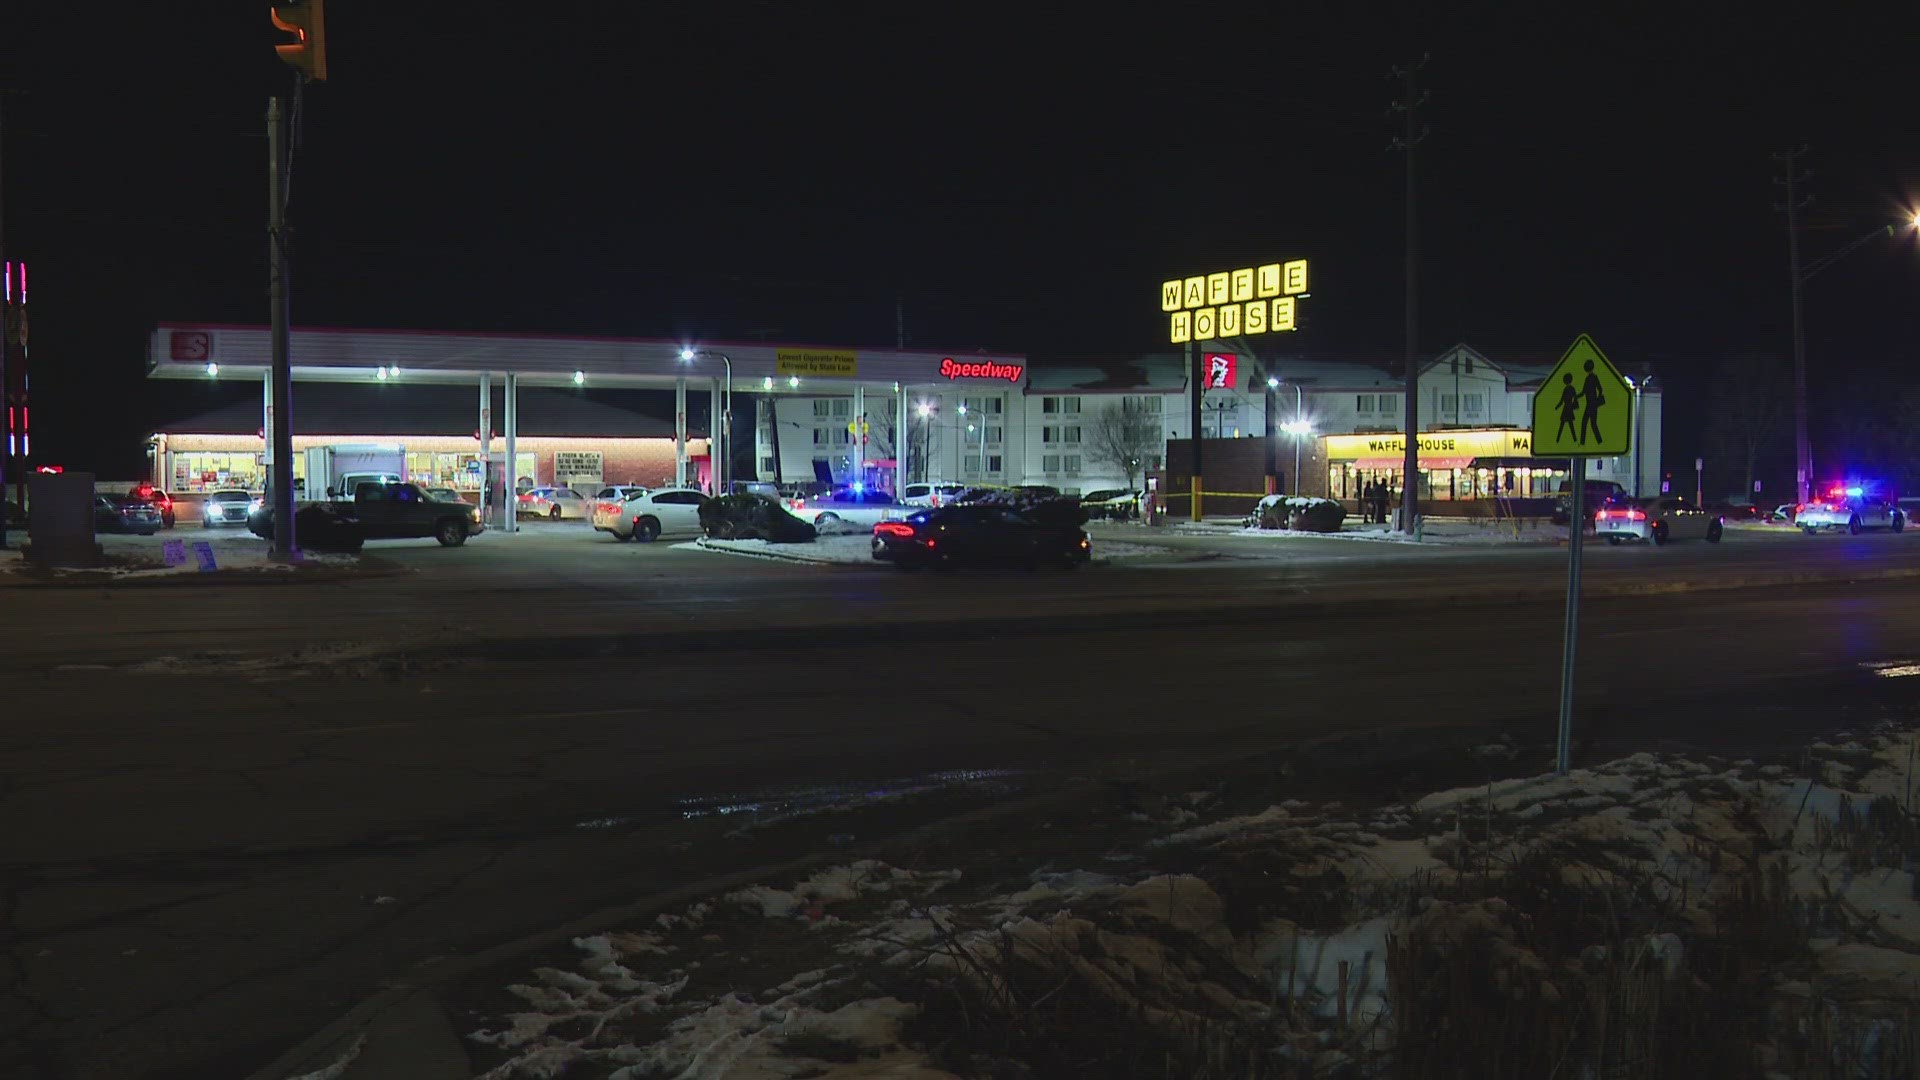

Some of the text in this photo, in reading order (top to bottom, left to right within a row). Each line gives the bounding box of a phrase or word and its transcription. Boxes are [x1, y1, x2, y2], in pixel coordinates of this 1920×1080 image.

[1164, 263, 1304, 308] WAFFLE
[1173, 301, 1291, 339] HOUSE
[777, 353, 802, 361] Lowest
[834, 355, 855, 363] Prices
[781, 361, 808, 369] Allowed
[809, 363, 818, 372] by
[939, 357, 1023, 383] Speedway
[1368, 439, 1455, 452] WAFFL HOUSE
[1512, 438, 1529, 450] WA
